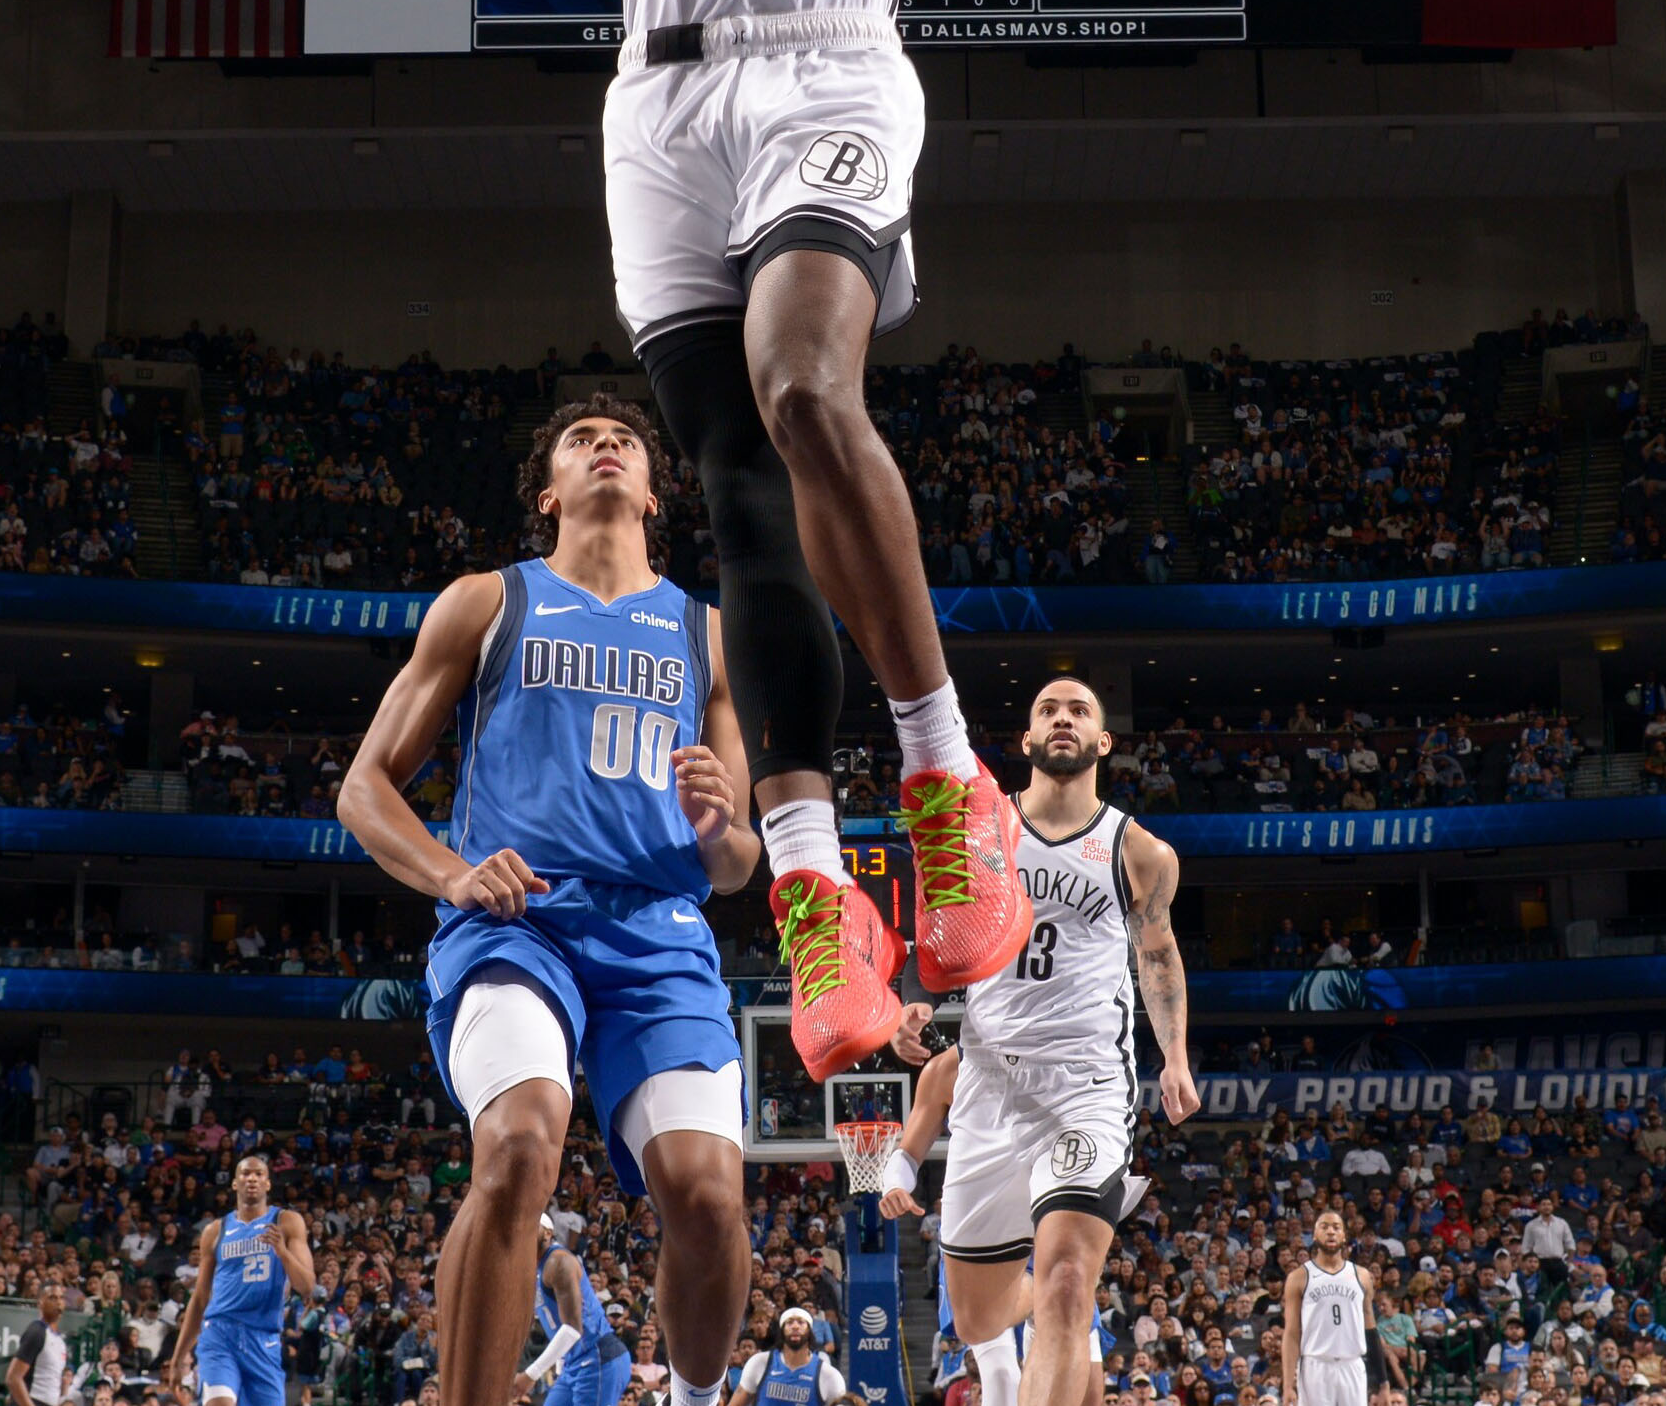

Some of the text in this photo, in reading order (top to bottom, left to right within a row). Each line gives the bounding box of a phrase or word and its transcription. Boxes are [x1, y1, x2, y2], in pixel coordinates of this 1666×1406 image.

[583, 28, 624, 41] GET
[922, 22, 1145, 36] DALLASMAVS.SHOP!
[1283, 583, 1477, 620] LET'S GO MAVS
[631, 610, 679, 632] chime
[522, 638, 685, 706] DALLAS
[590, 703, 679, 791] 00
[1247, 816, 1433, 848] LET'S GO MAVS
[841, 849, 885, 875] 7.3
[1081, 852, 1112, 864] GUIDE
[1083, 844, 1111, 856] YOUR
[1018, 868, 1113, 924] OOKLYN
[1294, 1075, 1452, 1113] PROUD
[1468, 1075, 1499, 1111] &
[1513, 1073, 1649, 1111] LOUD!
[243, 1254, 271, 1283] 23
[1310, 1284, 1357, 1302] BROOKLYN
[1333, 1304, 1341, 1325] 9
[858, 1338, 890, 1351] AT&T
